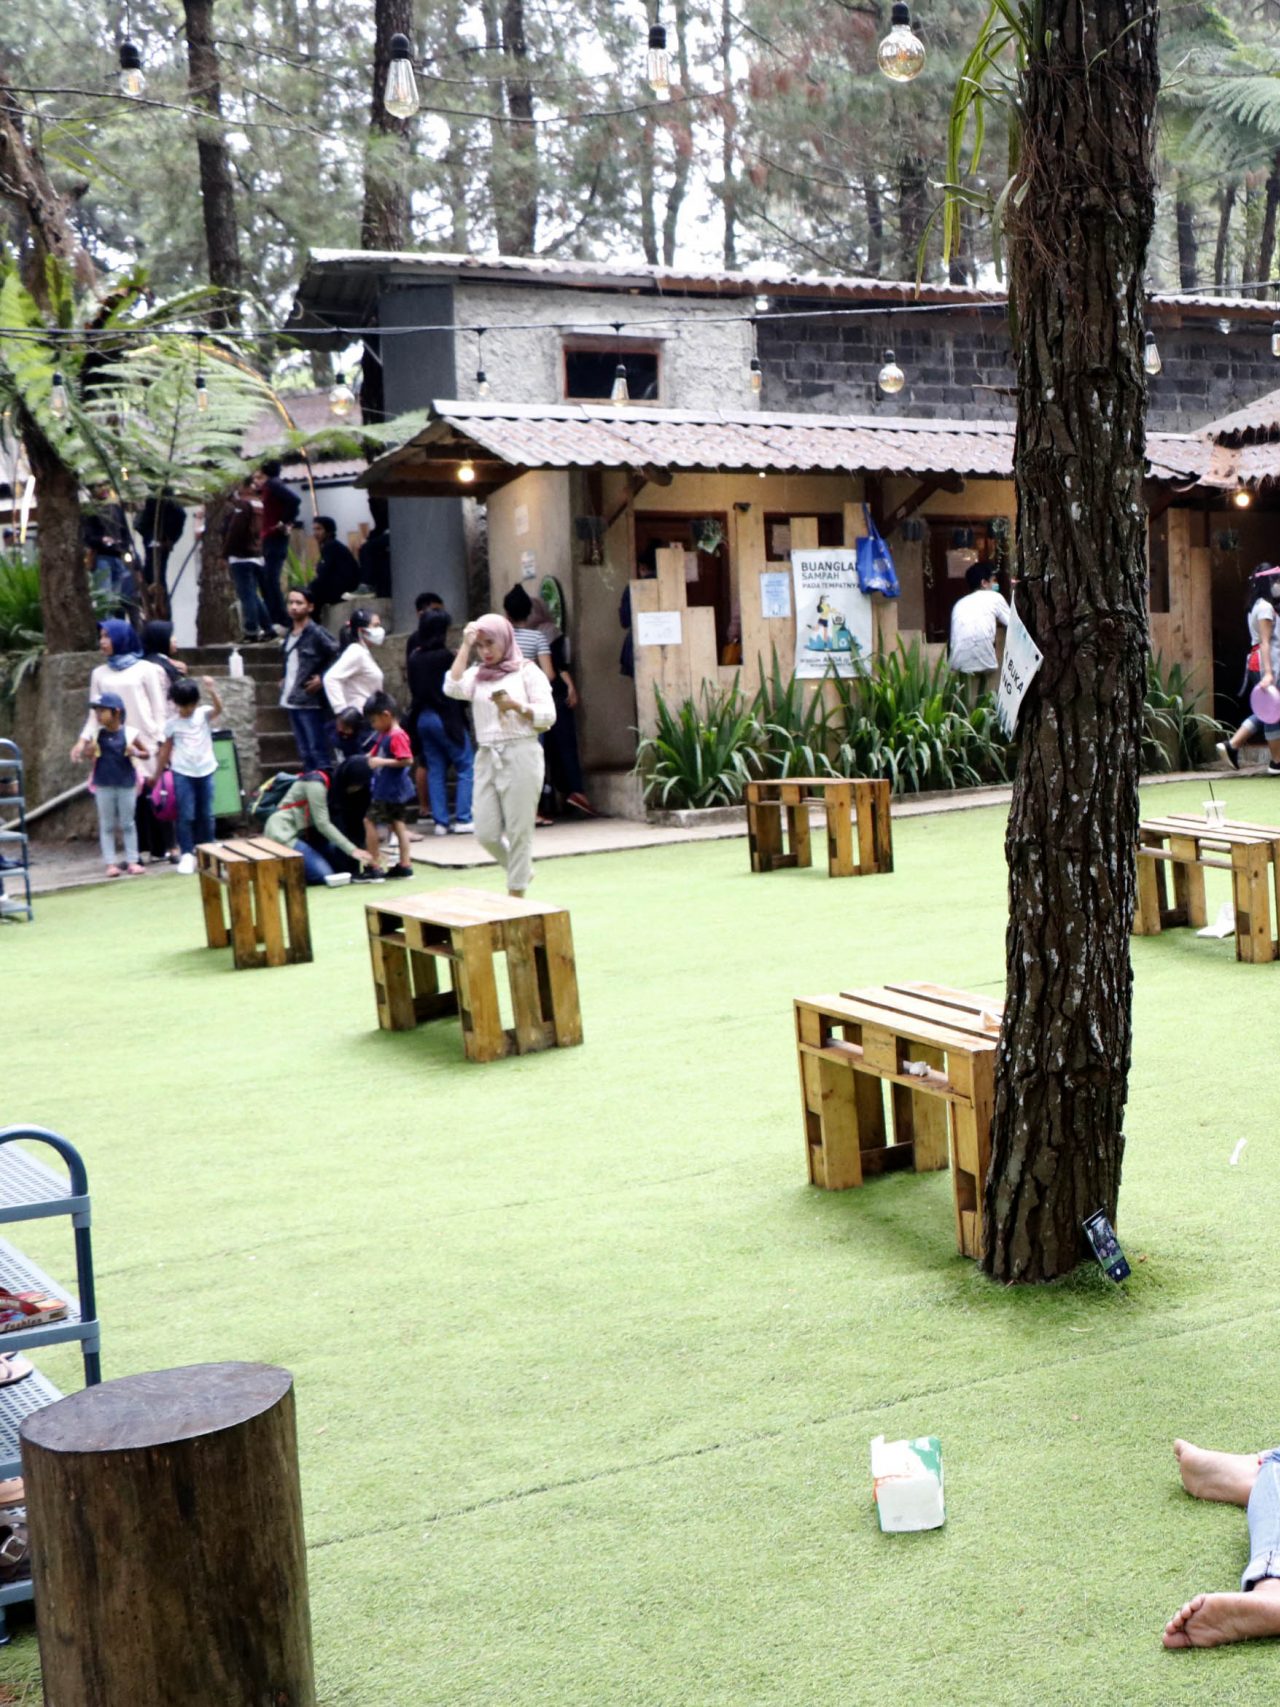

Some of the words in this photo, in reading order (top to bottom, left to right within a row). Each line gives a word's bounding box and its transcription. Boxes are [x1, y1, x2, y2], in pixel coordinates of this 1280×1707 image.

[801, 562, 857, 571] BUANGLA
[802, 572, 839, 580] SAMPAH
[1008, 659, 1024, 694] BUKA
